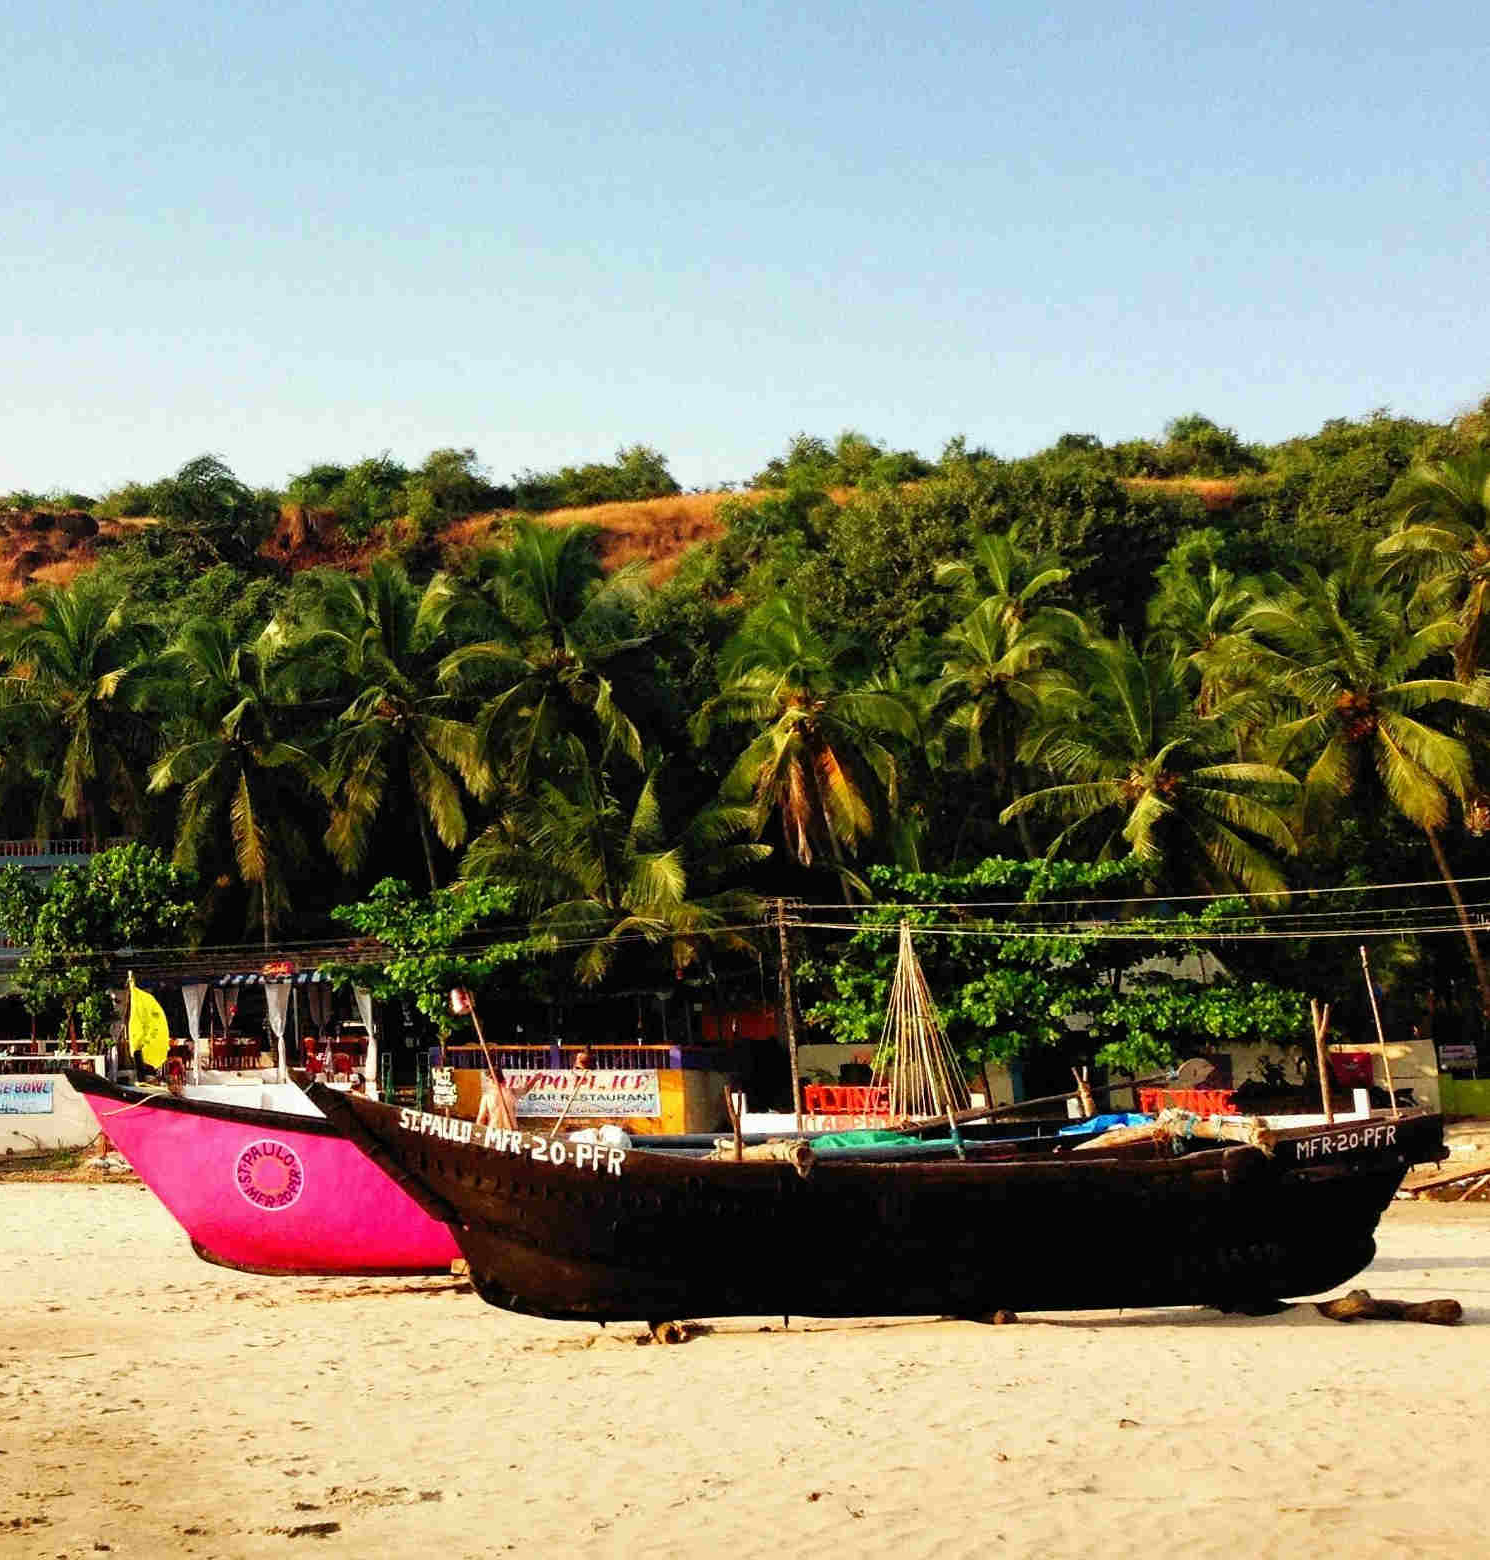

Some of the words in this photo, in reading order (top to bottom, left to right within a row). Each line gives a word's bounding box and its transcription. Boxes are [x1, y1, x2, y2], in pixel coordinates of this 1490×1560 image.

[15, 1081, 51, 1093] BOWL
[528, 1093, 556, 1101] BAR
[805, 1085, 889, 1112] FLYING
